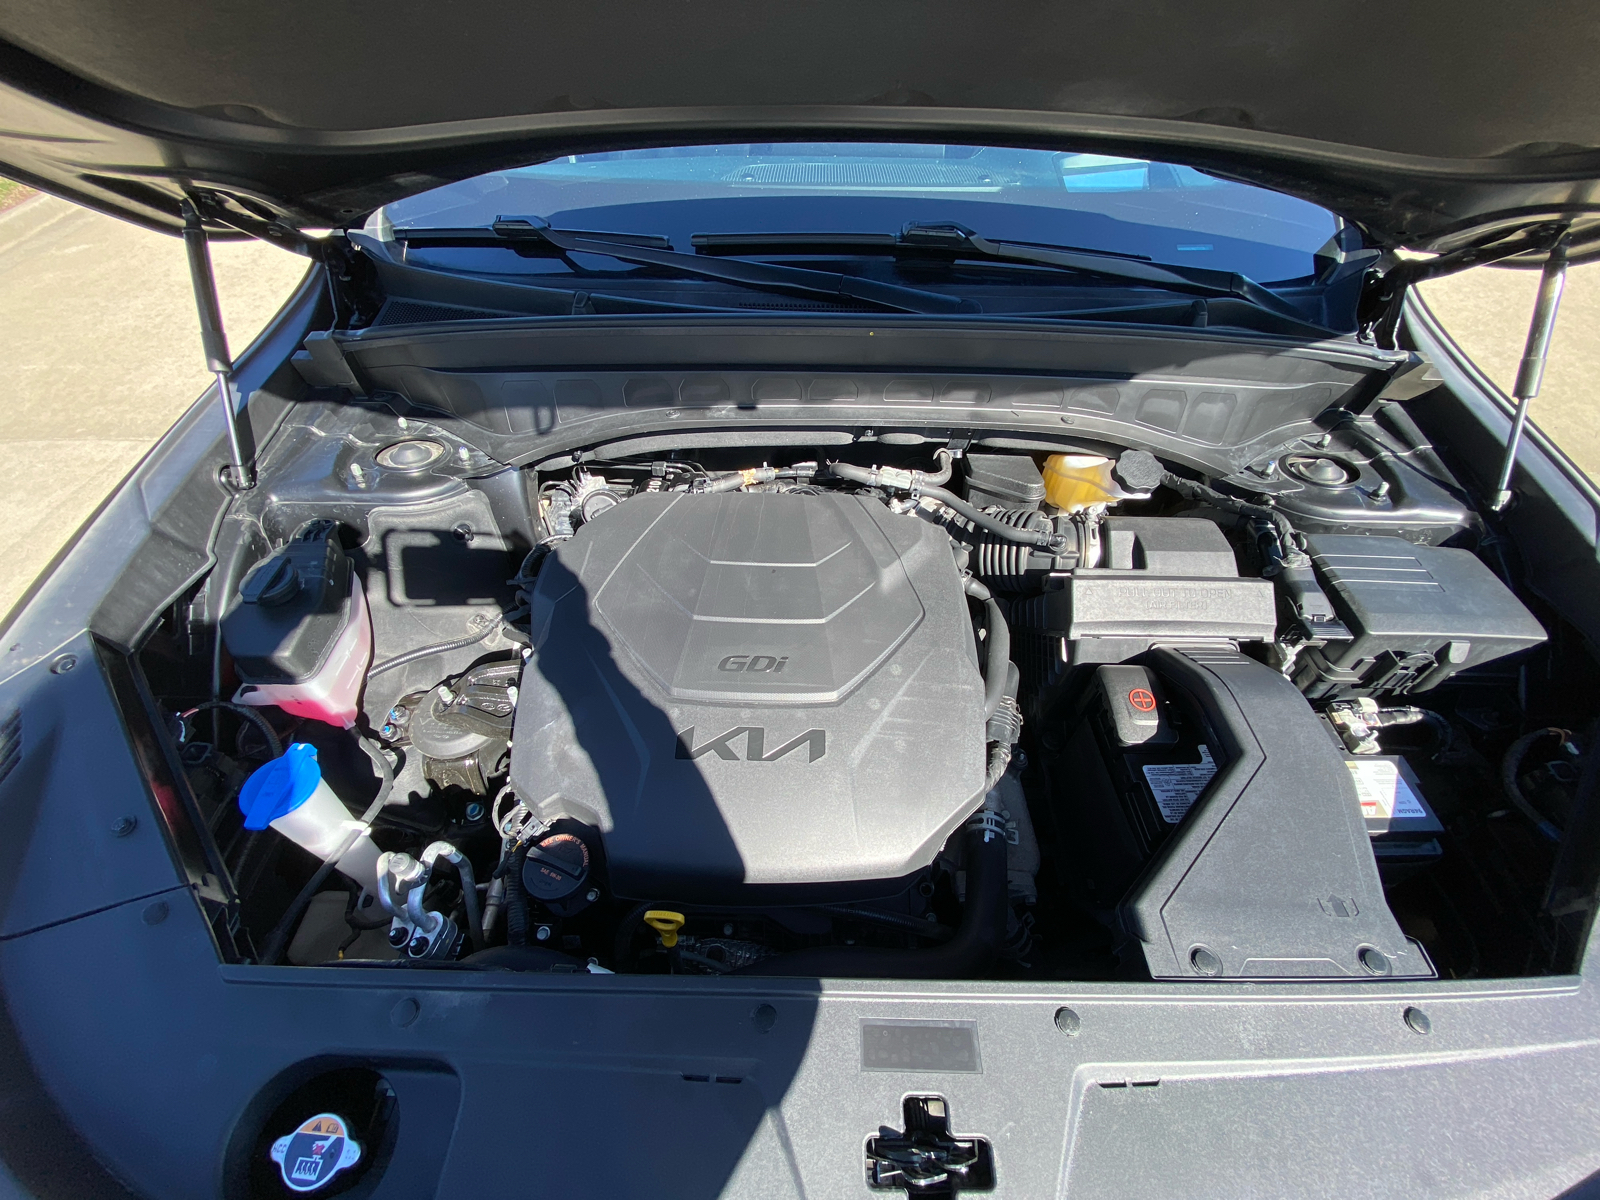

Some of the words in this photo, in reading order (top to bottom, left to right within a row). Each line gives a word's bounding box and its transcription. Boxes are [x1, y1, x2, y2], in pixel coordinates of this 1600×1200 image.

[1119, 586, 1146, 597] PULL
[1152, 587, 1177, 598] OUT
[1181, 587, 1198, 598] TO
[1200, 588, 1232, 599] OPEN
[717, 655, 789, 673] GDi
[579, 844, 589, 867] MANUAL
